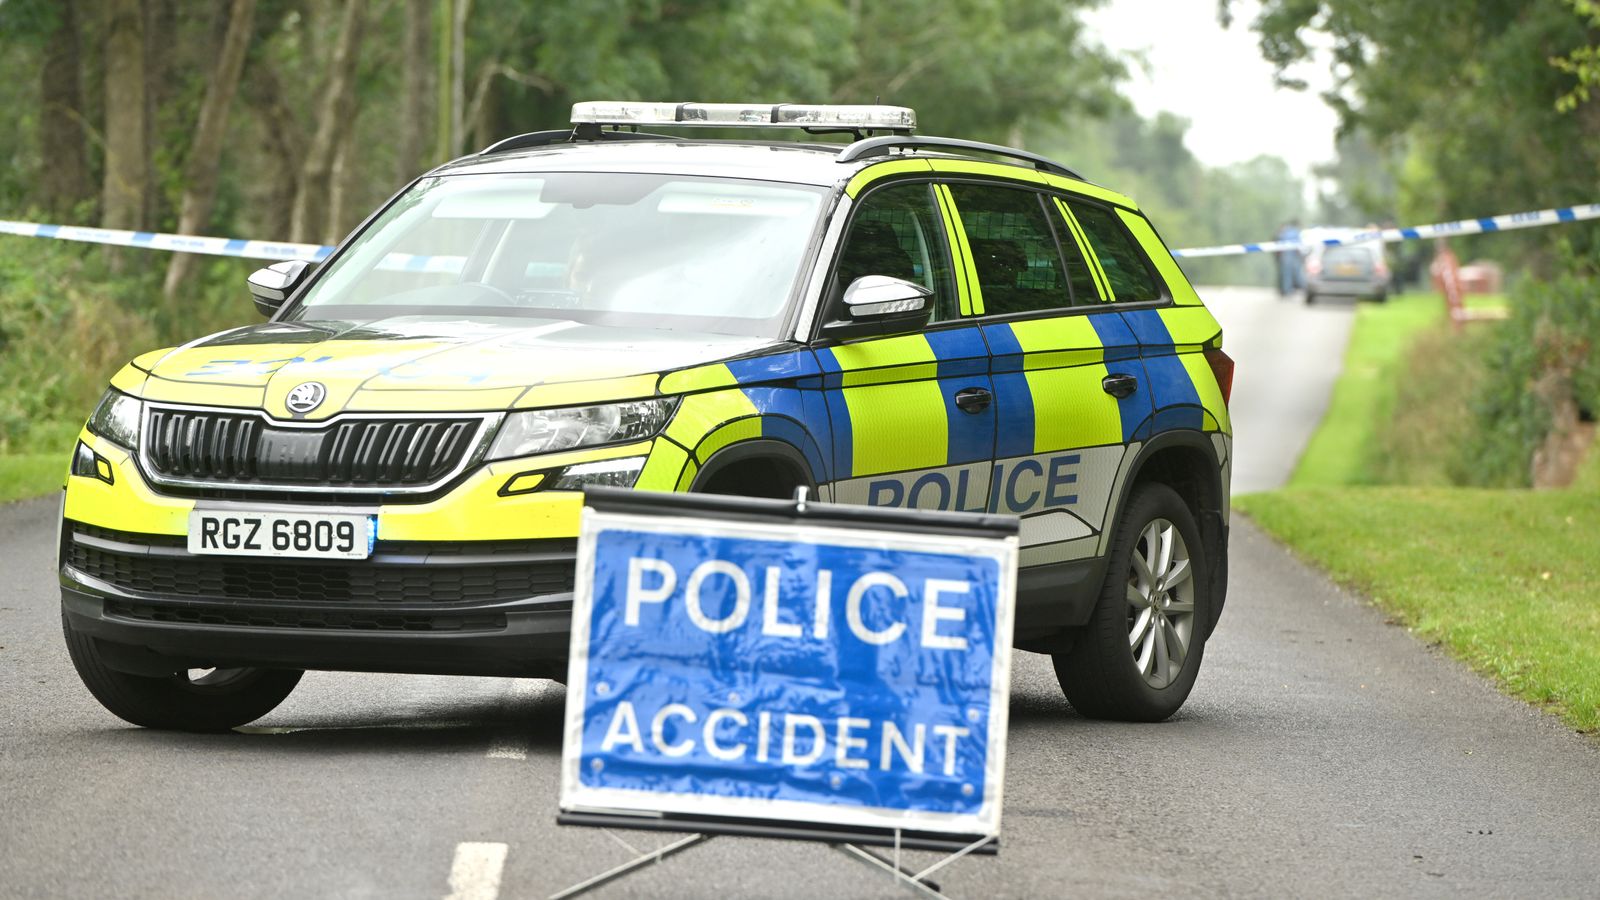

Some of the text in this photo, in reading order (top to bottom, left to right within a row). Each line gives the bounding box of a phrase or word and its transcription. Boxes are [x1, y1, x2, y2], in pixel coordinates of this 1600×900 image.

[201, 517, 354, 552] RGZ 6809
[624, 556, 972, 651] POLICE
[600, 701, 970, 776] ACCIDENT
